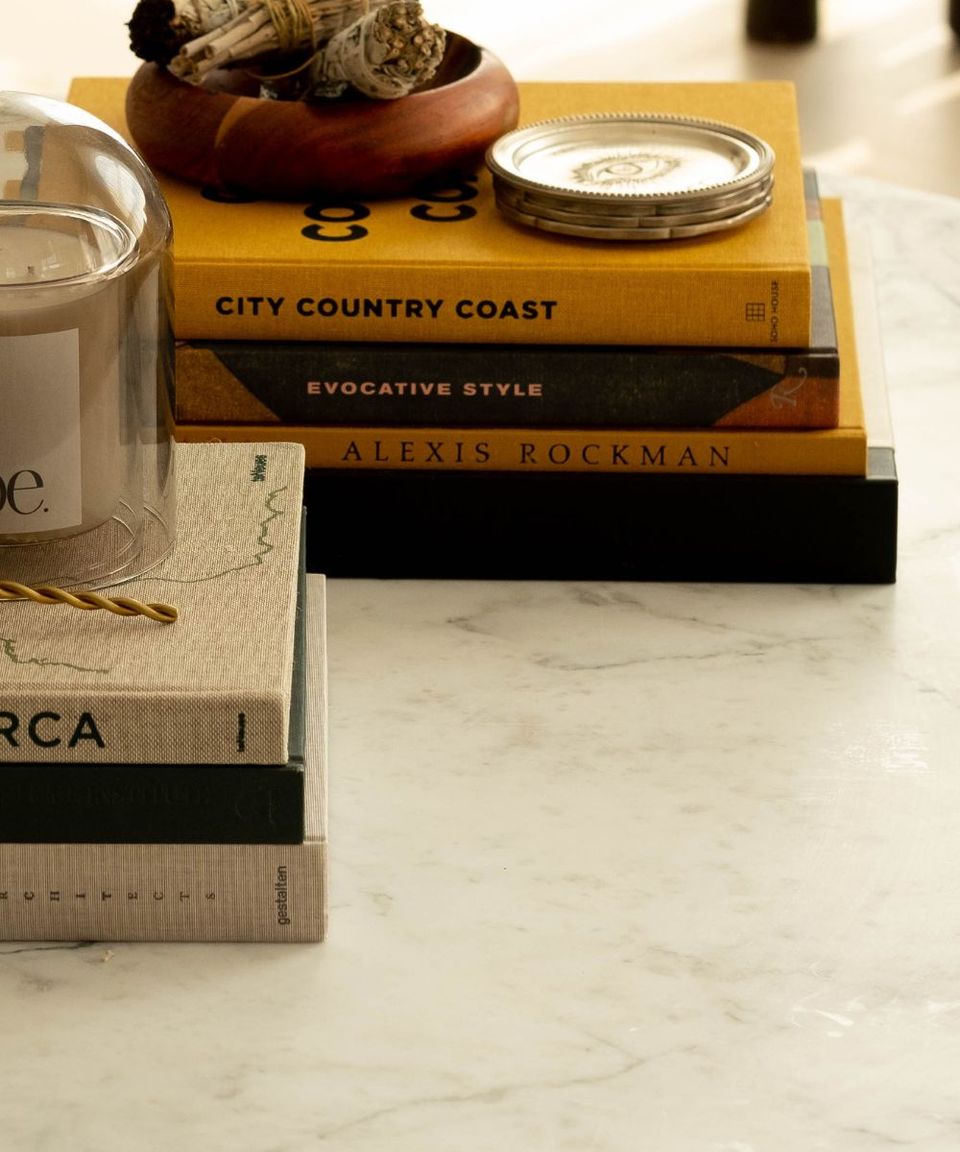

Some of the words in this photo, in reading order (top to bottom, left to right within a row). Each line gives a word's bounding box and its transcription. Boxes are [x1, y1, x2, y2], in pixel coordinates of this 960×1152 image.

[215, 296, 284, 316] CITY
[296, 298, 445, 319] COUNTRY
[455, 300, 558, 320] COAST
[307, 381, 452, 396] EVOCATIVE
[463, 383, 543, 396] STYLE
[342, 442, 490, 463] ALEXIS
[519, 444, 732, 466] ROCKMAN
[274, 865, 291, 925] gestalten
